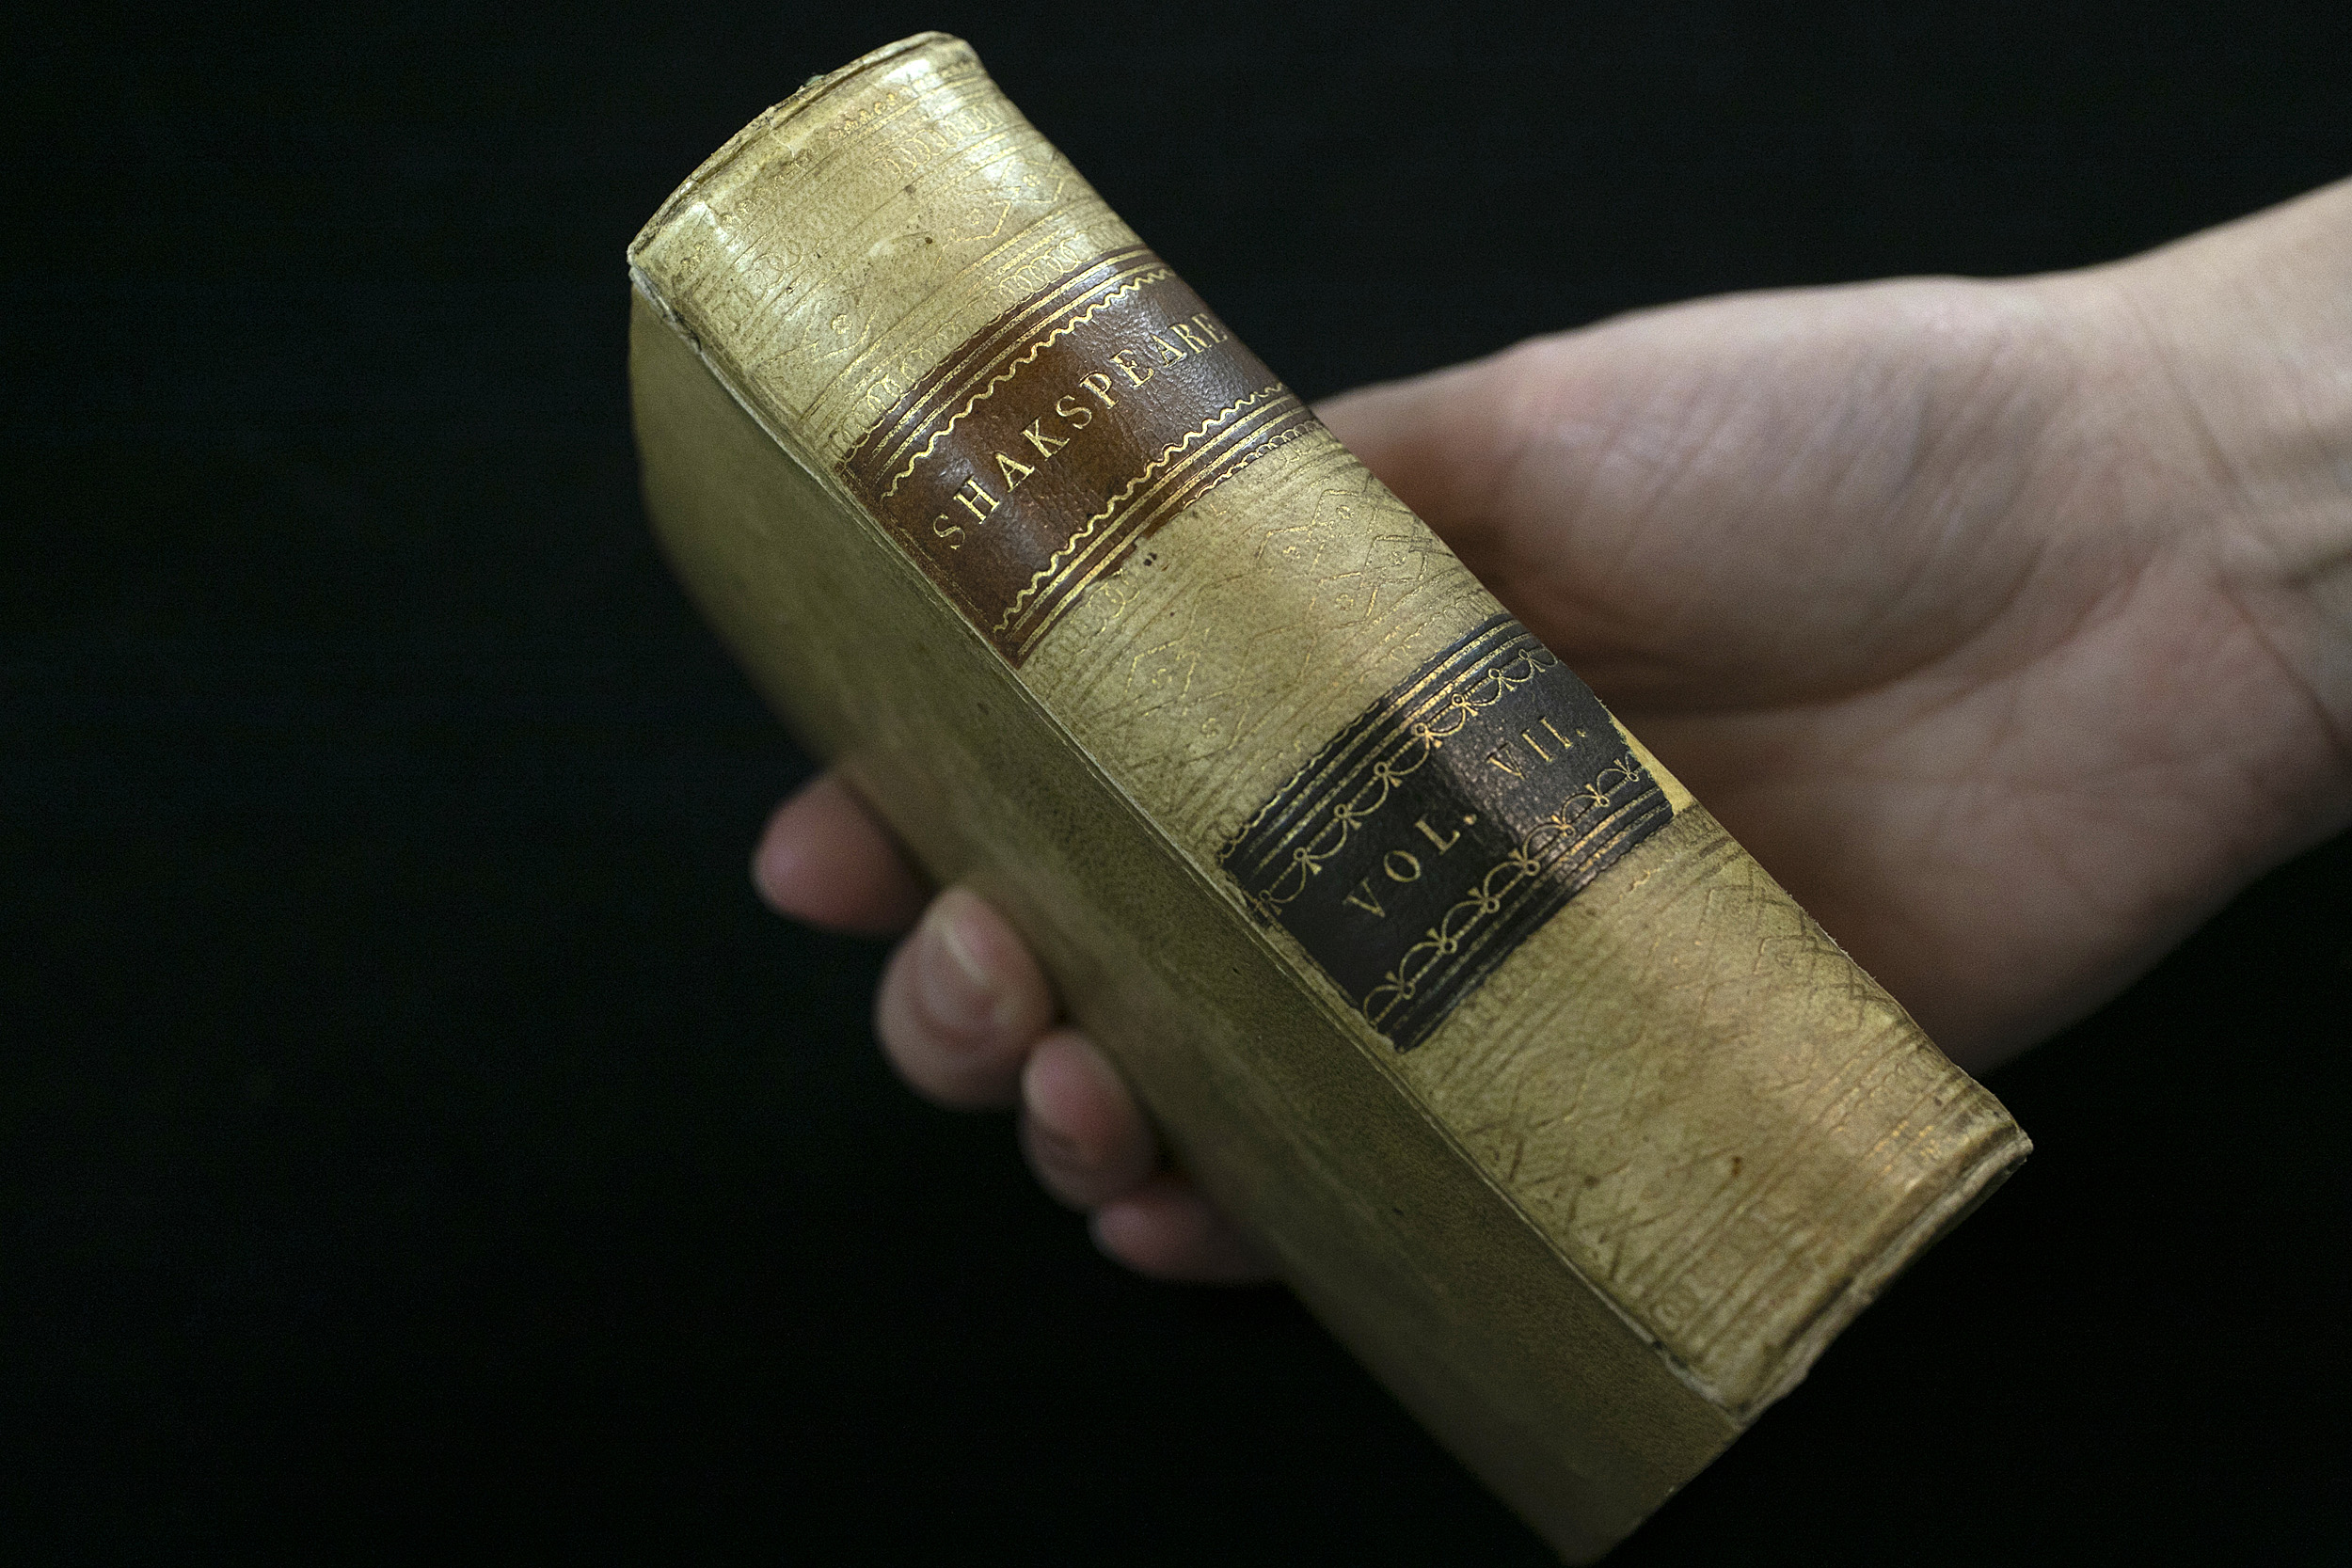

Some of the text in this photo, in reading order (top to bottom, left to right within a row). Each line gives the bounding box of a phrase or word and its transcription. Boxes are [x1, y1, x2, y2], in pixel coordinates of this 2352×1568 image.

[932, 312, 1228, 550] SHAKSPEARE
[1343, 717, 1587, 918] VOL. VII.
